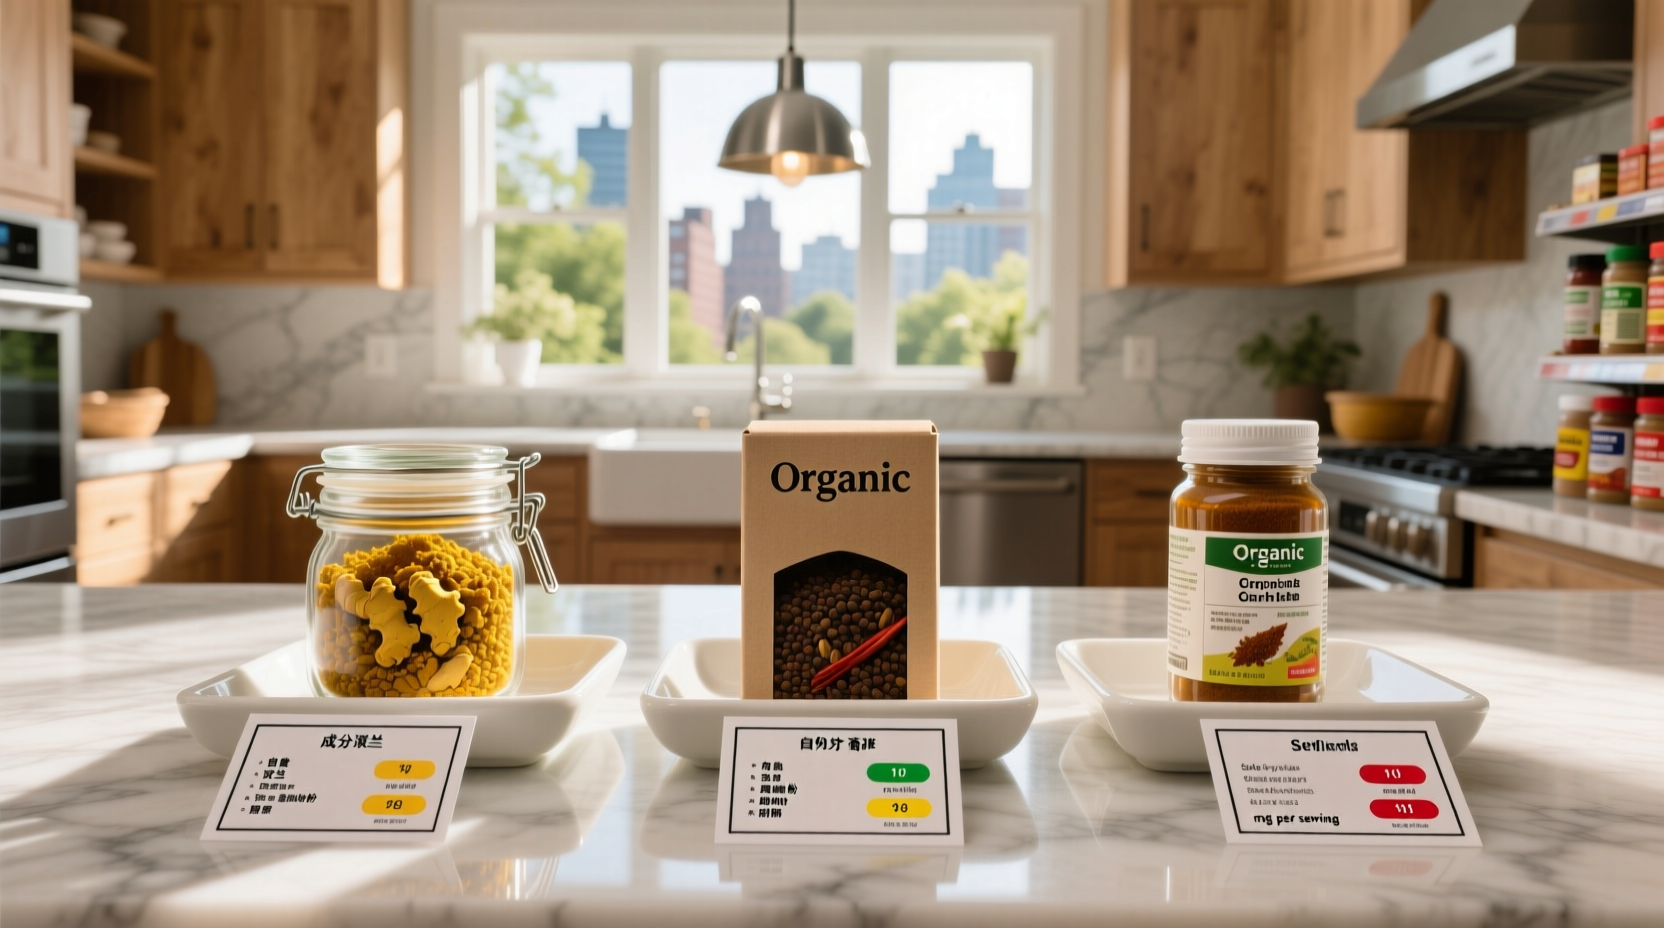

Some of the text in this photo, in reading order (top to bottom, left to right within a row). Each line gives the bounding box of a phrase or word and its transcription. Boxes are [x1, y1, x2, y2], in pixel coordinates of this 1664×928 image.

[771, 461, 911, 502] Organic
[1232, 543, 1304, 568] Organic
[891, 767, 906, 778] 10
[1253, 814, 1273, 826] mg
[1276, 815, 1295, 826] per
